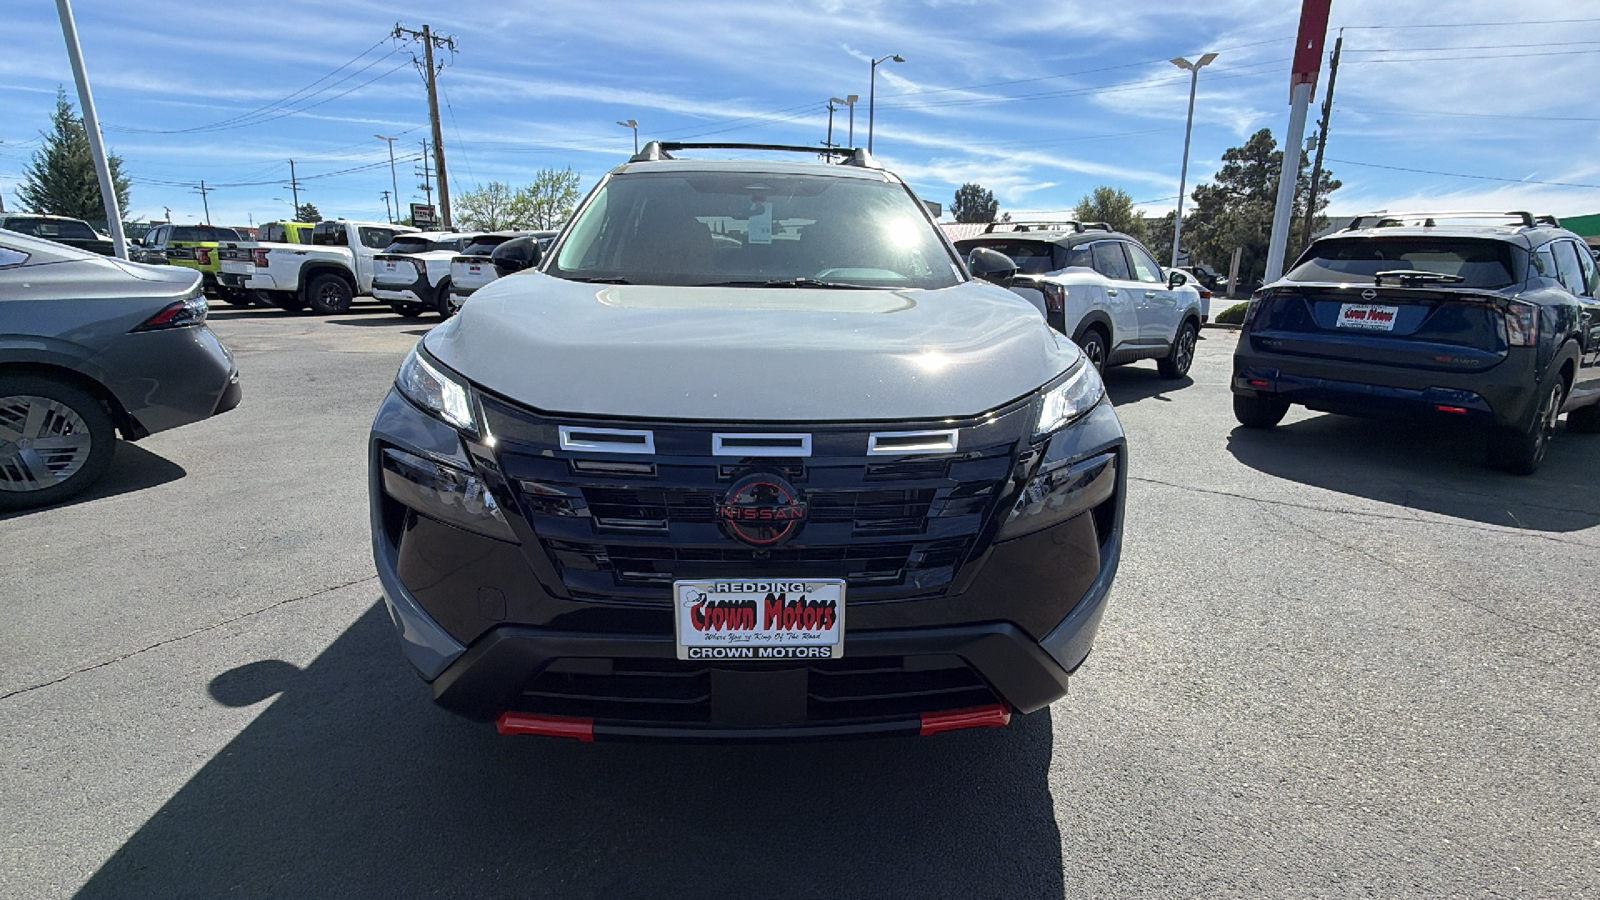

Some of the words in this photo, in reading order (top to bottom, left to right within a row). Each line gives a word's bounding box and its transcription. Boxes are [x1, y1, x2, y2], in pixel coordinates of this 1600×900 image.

[721, 506, 803, 519] NISSAN
[716, 583, 804, 593] REDDING
[690, 594, 757, 631] Crown
[764, 593, 836, 631] Motors
[728, 633, 752, 643] You're
[754, 633, 772, 641] King
[774, 633, 784, 642] Of
[689, 647, 754, 658] CROWN
[758, 647, 831, 658] MOTORS
